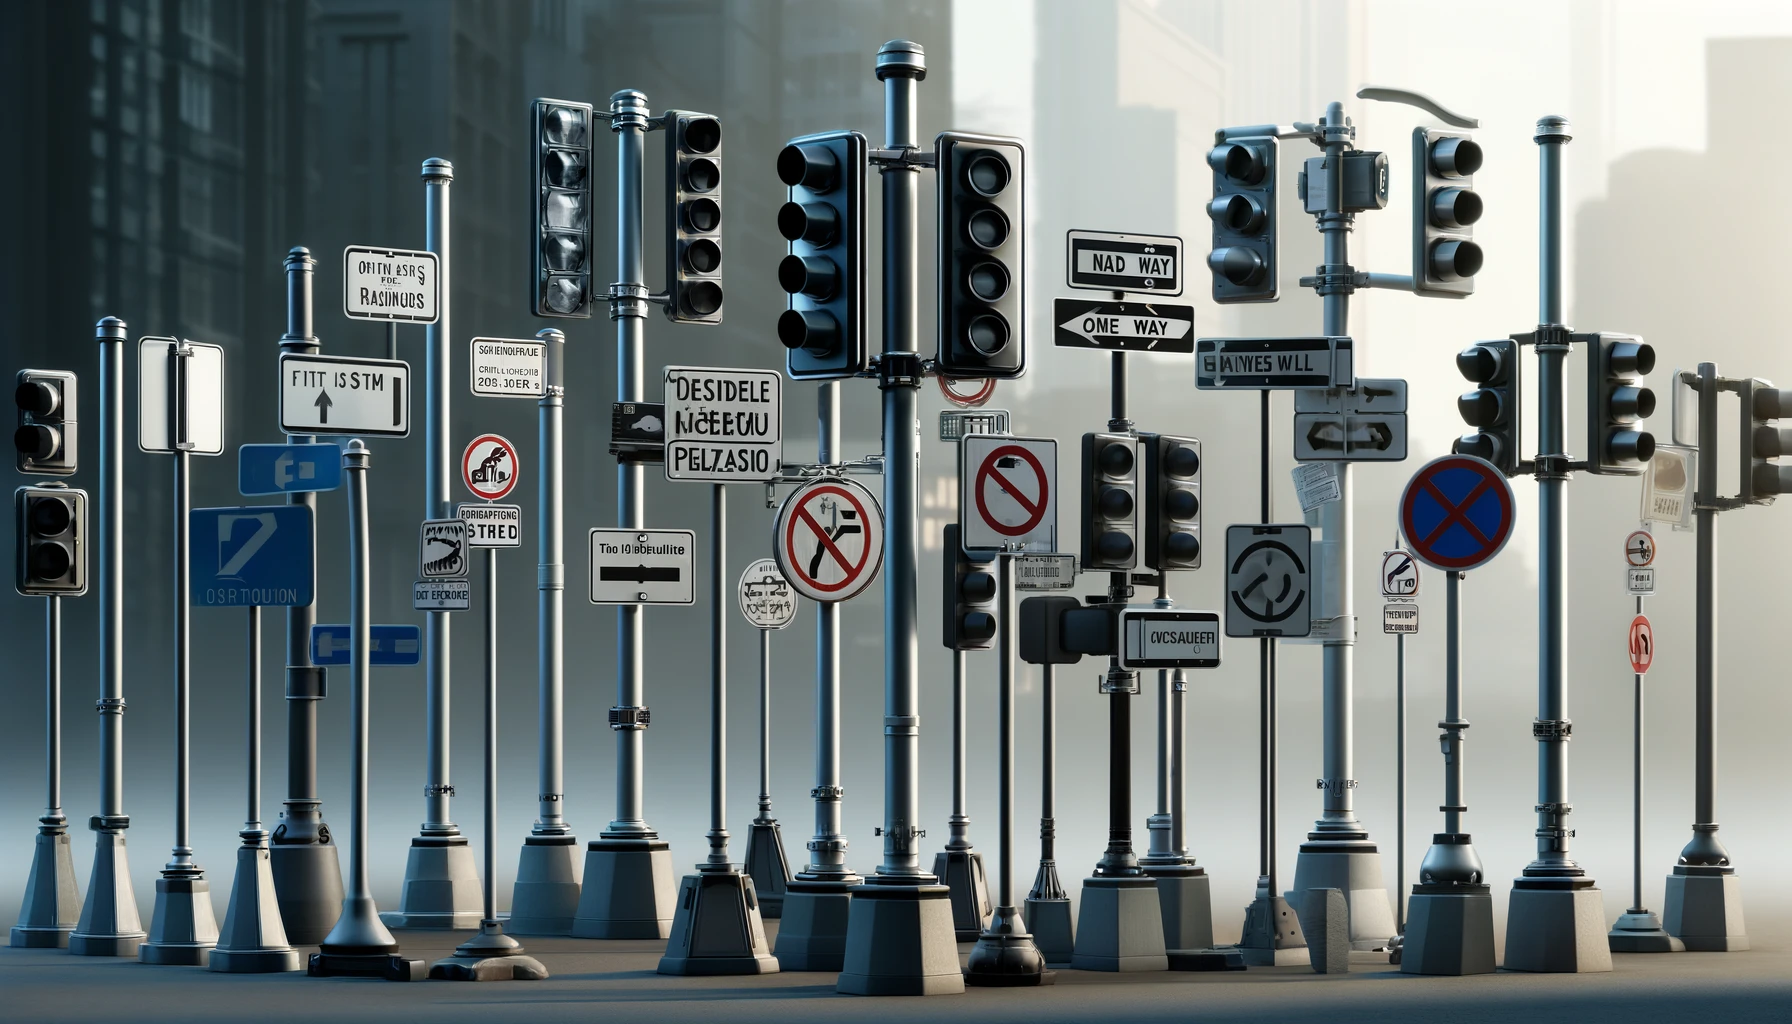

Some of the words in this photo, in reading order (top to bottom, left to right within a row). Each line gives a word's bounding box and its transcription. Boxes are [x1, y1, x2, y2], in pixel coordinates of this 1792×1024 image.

[1093, 254, 1125, 273] NAD
[1138, 256, 1170, 276] WAY
[1133, 319, 1168, 336] WAY
[676, 375, 770, 403] DESIDELE
